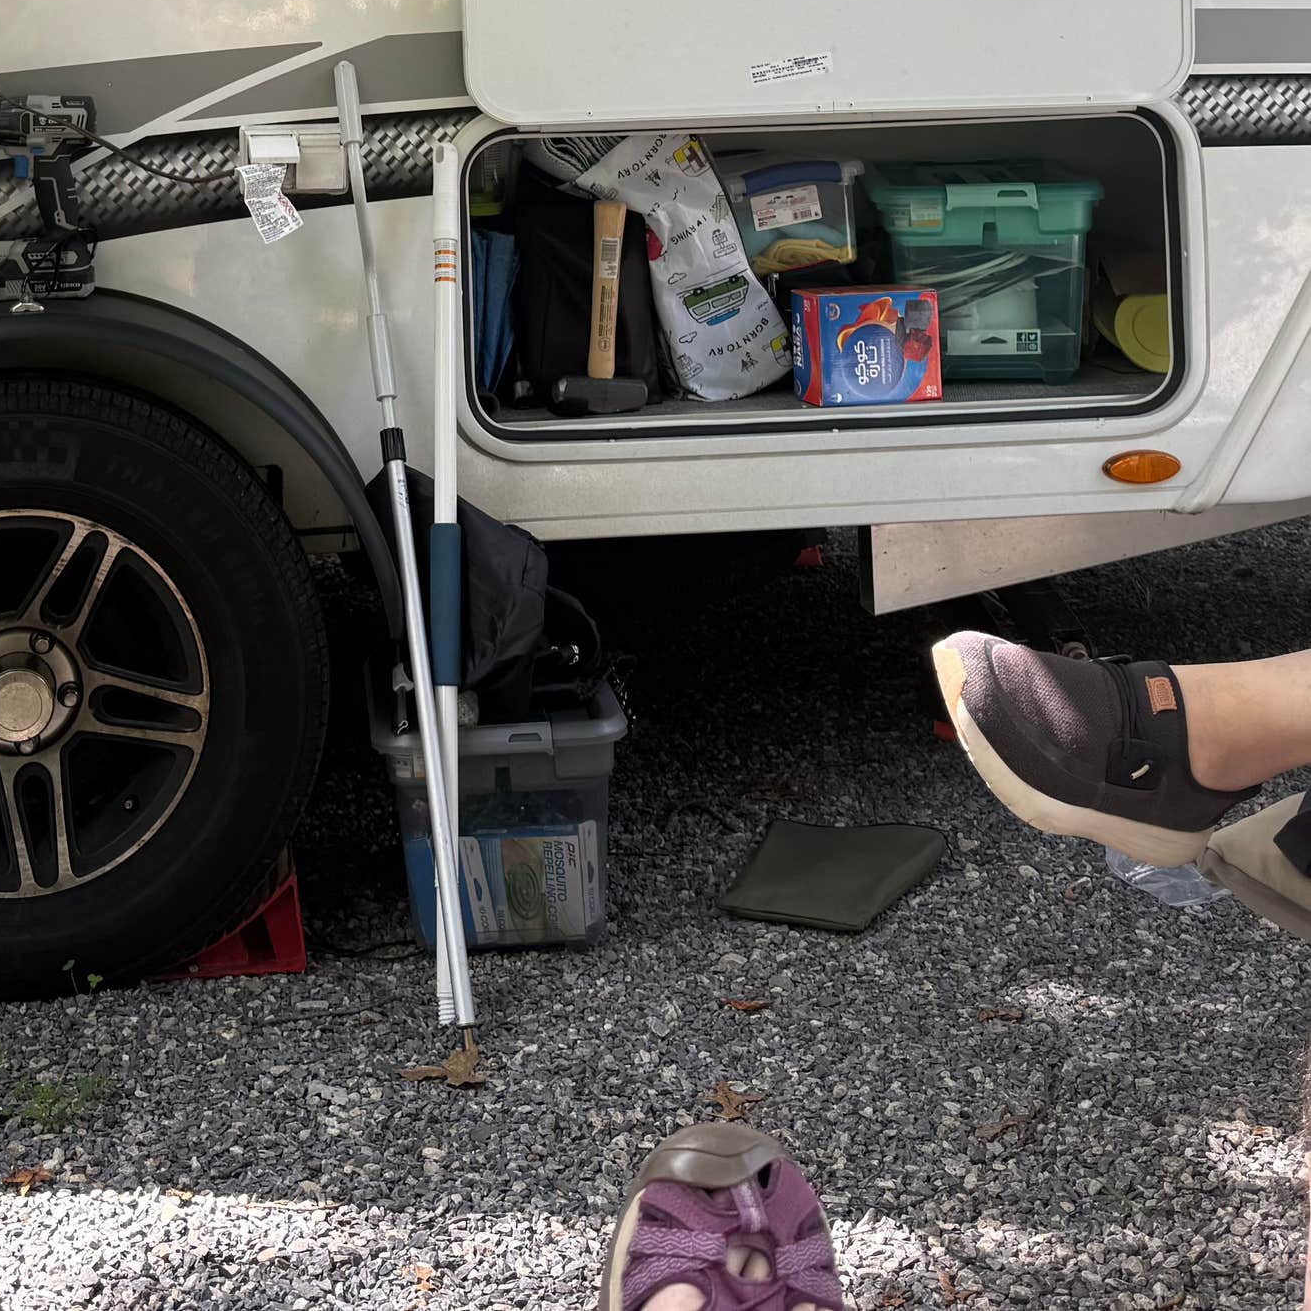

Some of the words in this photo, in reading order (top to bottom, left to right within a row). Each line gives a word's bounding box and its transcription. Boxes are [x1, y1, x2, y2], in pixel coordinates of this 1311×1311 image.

[632, 159, 647, 172] TO
[617, 167, 631, 180] RV
[742, 317, 769, 346] BORN
[707, 345, 725, 358] RV
[726, 340, 740, 354] TO
[543, 840, 557, 904] REPELLING
[553, 840, 567, 902] MOSQUITO
